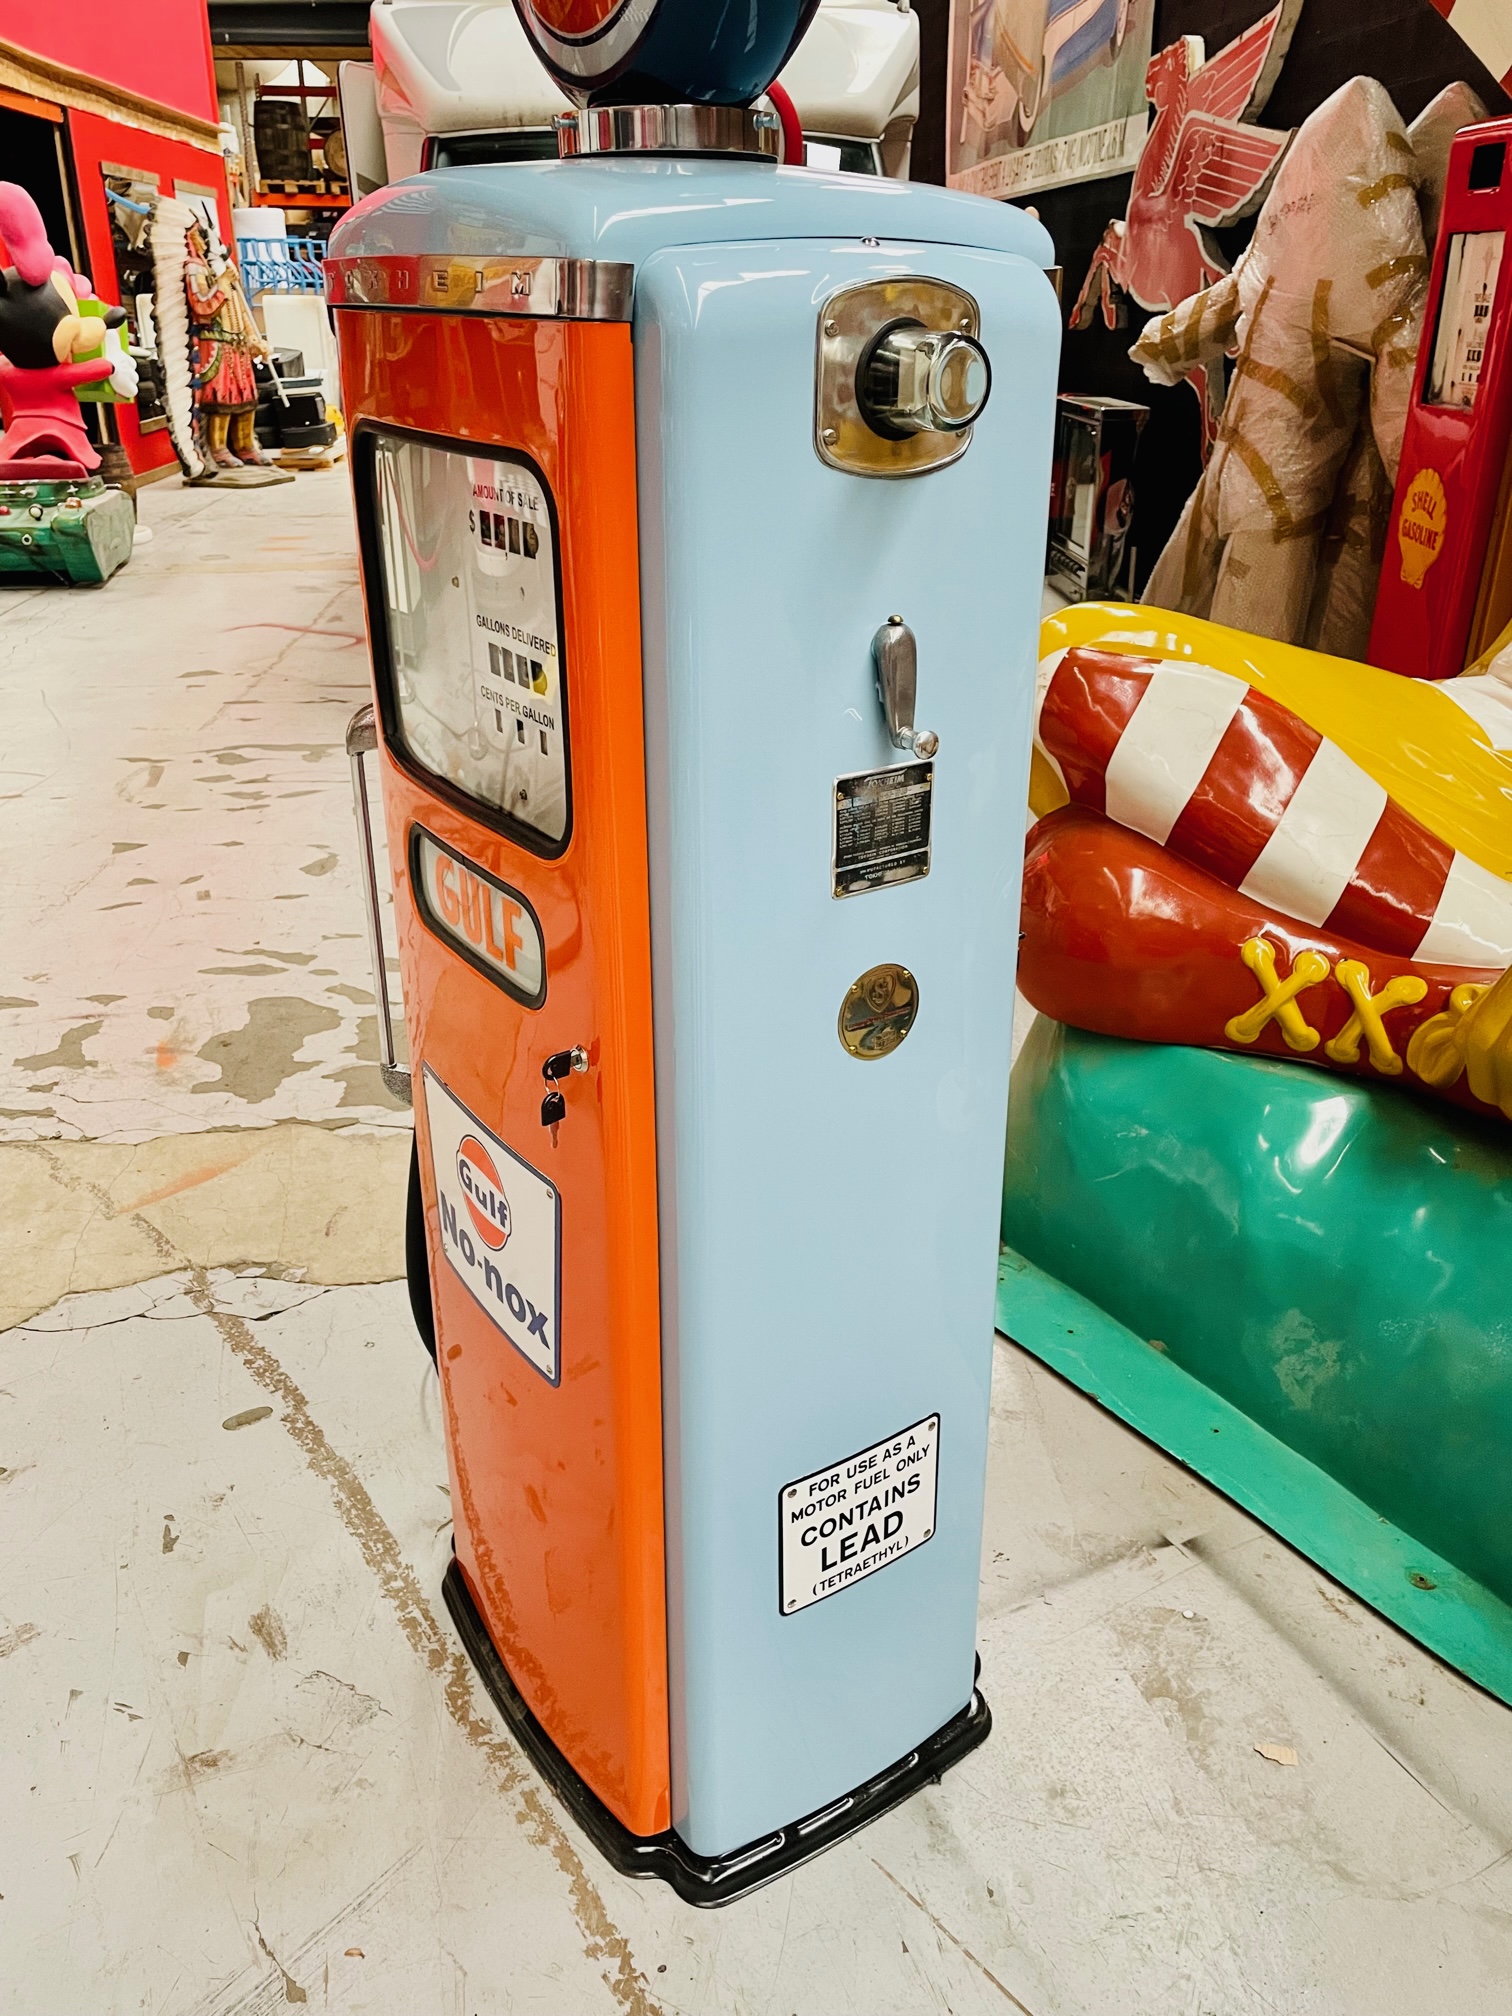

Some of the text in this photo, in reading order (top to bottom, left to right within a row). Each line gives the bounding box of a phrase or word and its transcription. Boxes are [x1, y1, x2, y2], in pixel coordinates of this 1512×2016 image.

[473, 484, 539, 511] AMOUNT OF SALE
[1412, 491, 1437, 520] SHELL
[1402, 518, 1439, 551] GASOLINE
[476, 614, 557, 657] GALLONS DELIVERED
[480, 685, 555, 730] CENTS PER GALLON
[435, 854, 523, 971] GULF
[459, 1158, 509, 1228] Gulf
[791, 1444, 930, 1524] MOTOR FUEL ONLY
[809, 1435, 916, 1497] FOR USE AS A
[801, 1473, 921, 1547] CONTAINS
[812, 1535, 909, 1595] (TETRAETHYL)
[821, 1510, 904, 1572] LEAD
